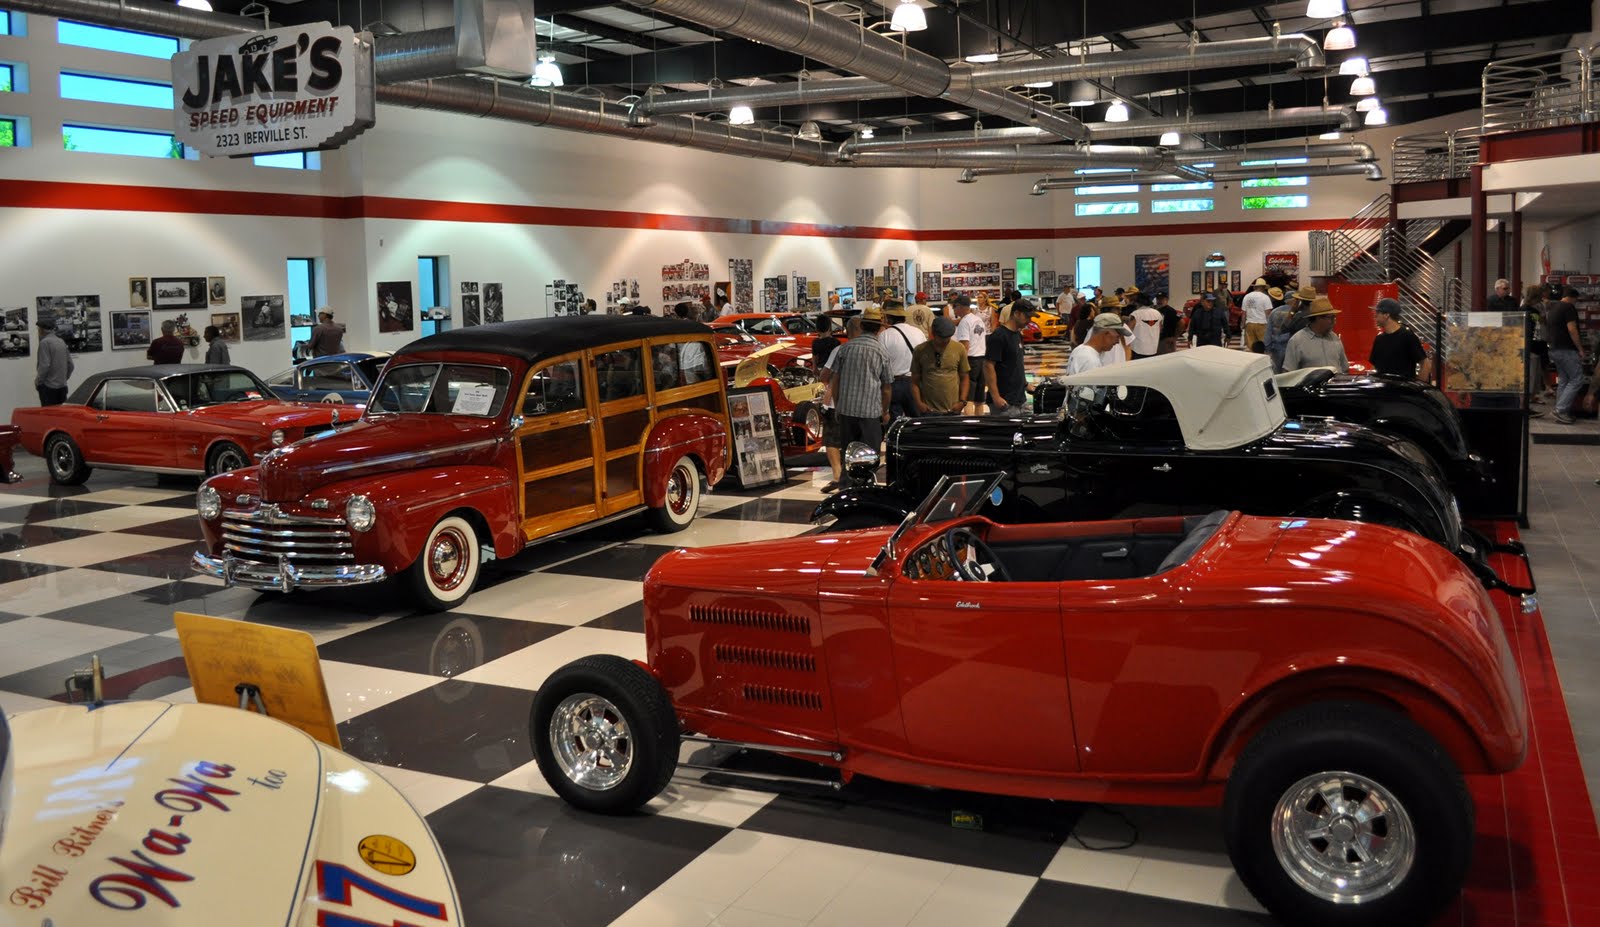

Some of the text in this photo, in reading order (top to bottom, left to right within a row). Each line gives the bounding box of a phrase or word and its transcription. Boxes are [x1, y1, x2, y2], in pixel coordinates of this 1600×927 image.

[182, 33, 343, 110] JAKE'S
[190, 96, 339, 128] SPEED EQUIPMENT
[216, 126, 308, 148] 2323 IBERVILLE ST.
[247, 768, 288, 790] too
[89, 760, 241, 911] Wa-Wa
[9, 863, 68, 910] Bill
